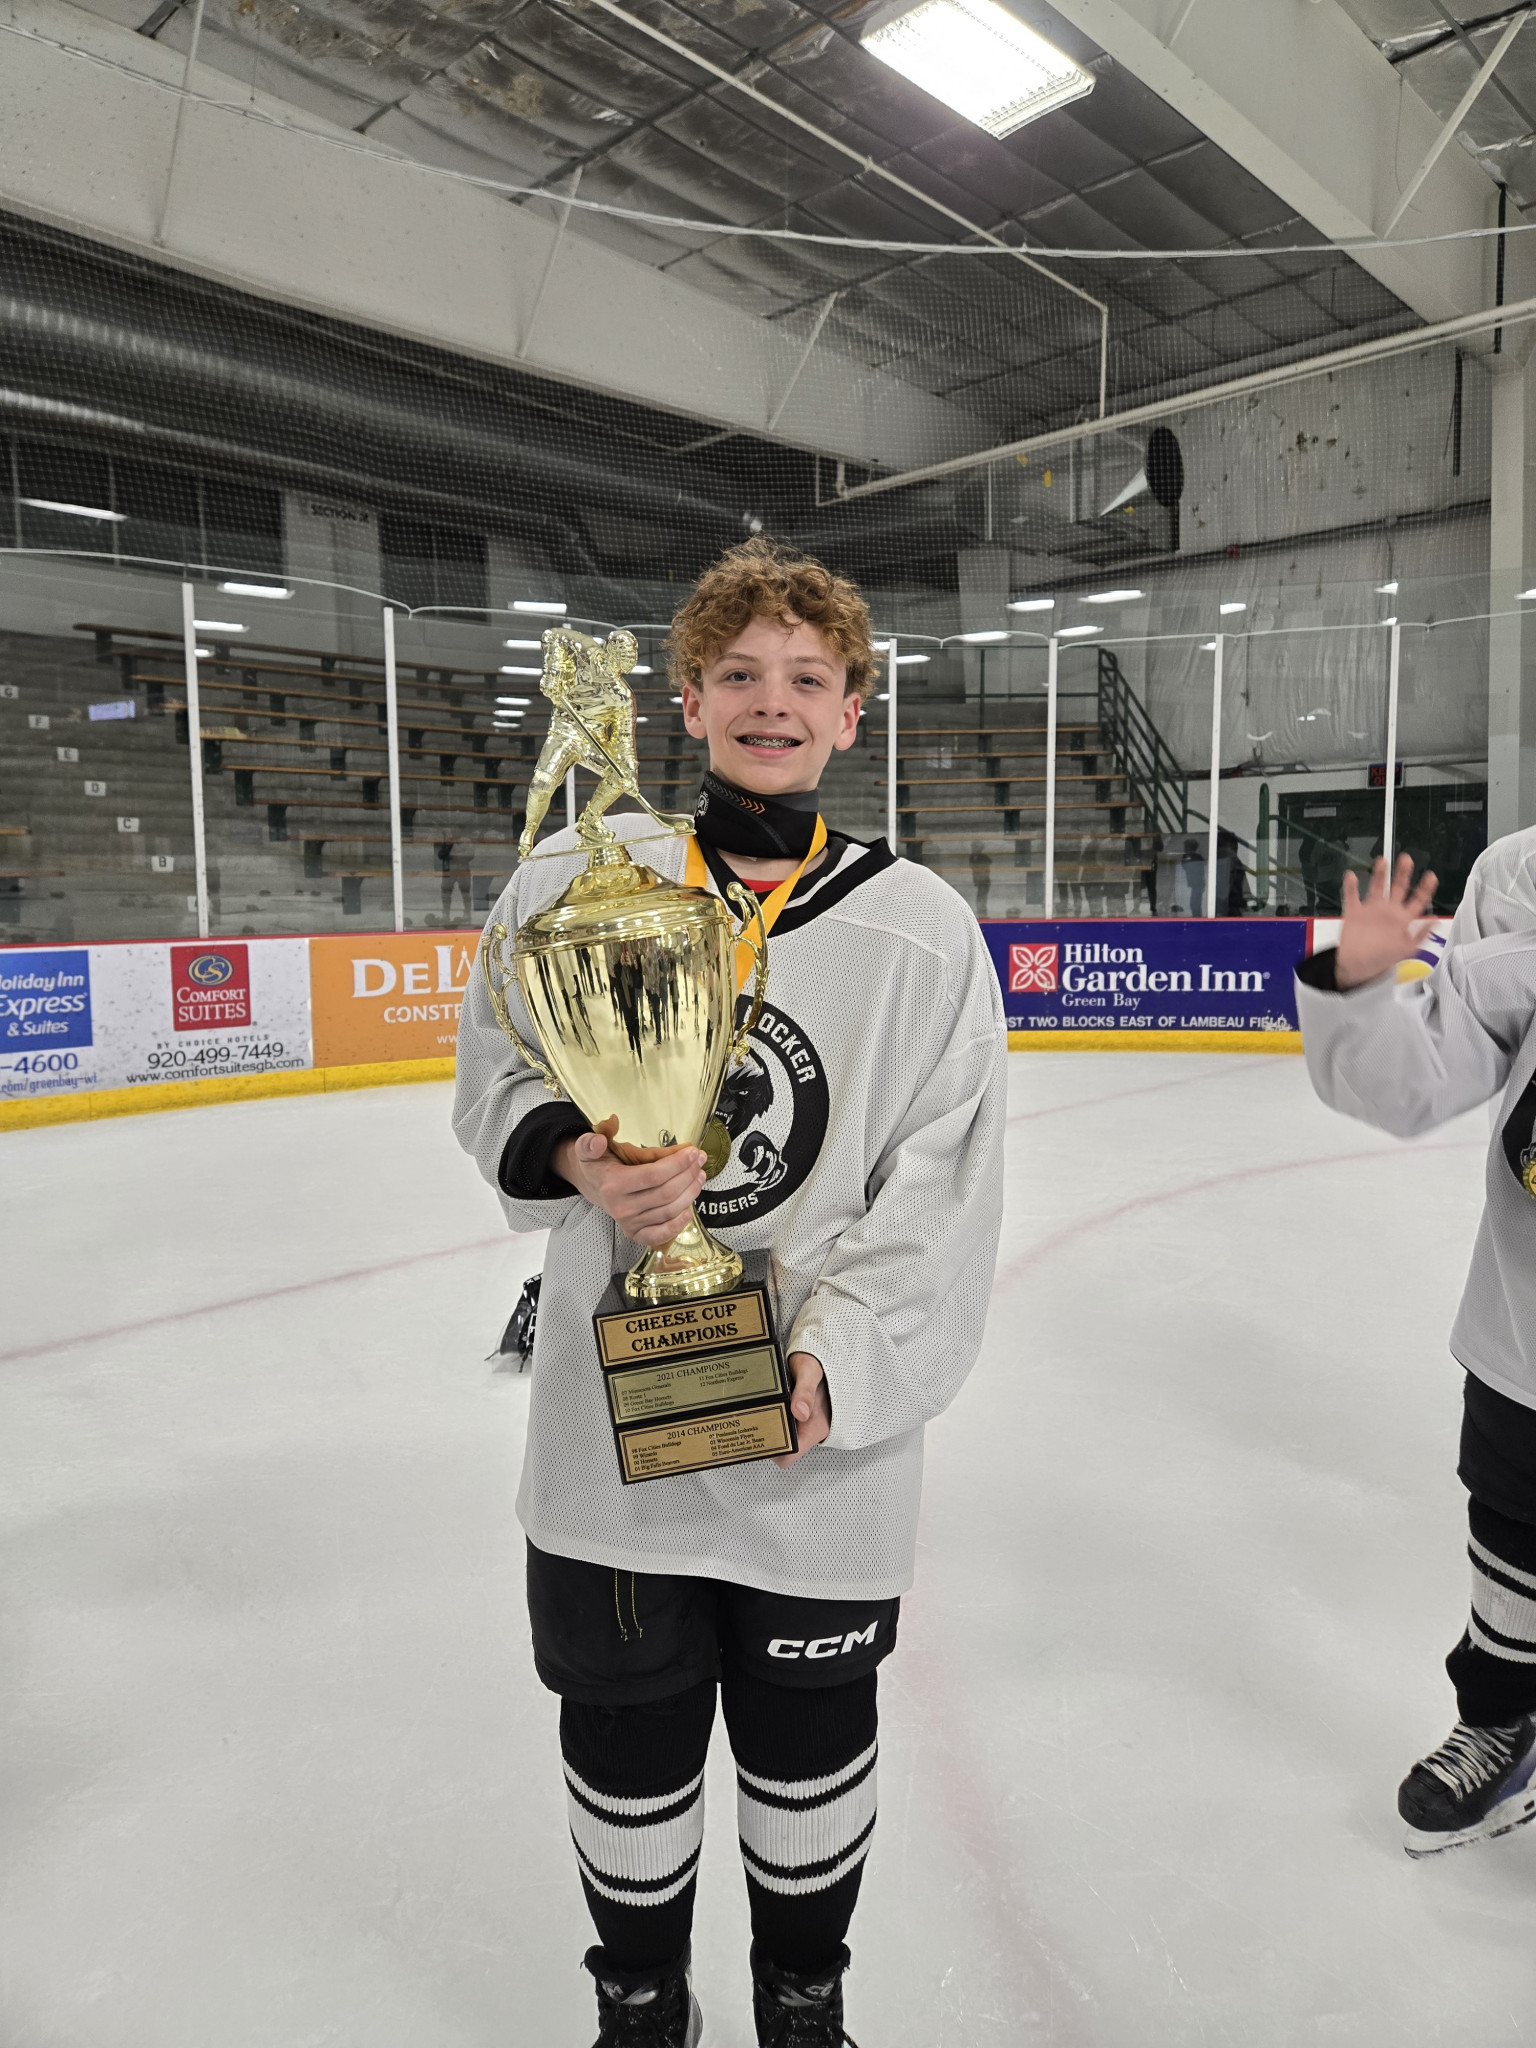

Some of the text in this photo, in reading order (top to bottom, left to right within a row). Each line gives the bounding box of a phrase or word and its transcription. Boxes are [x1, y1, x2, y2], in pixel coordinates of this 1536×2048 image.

[123, 819, 131, 828] C
[159, 857, 167, 867] B
[1064, 944, 1144, 964] Hilton
[58, 971, 84, 987] Inn
[1062, 964, 1265, 992] Garden Inn
[177, 987, 246, 1004] COMFORT
[1062, 993, 1141, 1010] Green Bay
[178, 1002, 246, 1022] SUITES
[7, 1020, 69, 1037] & Suites
[1028, 1016, 1058, 1027] TWO
[1062, 1016, 1115, 1027] BLOCKS
[1120, 1016, 1153, 1027] EAST
[1158, 1016, 1176, 1027] OF
[1181, 1016, 1244, 1027] LAMBEAU
[1250, 1016, 1288, 1029] FIELD
[178, 1038, 220, 1047] CHOICE
[228, 1034, 269, 1044] HOTELS
[148, 1042, 284, 1069] 920-499-7449
[126, 1057, 304, 1083] www.comfortsuitesgb.com
[694, 1192, 758, 1215] ADGERS
[626, 1304, 737, 1334] CHEESE CUP
[632, 1323, 738, 1352] CHAMPIONS
[657, 1362, 730, 1382] 2021 CHAMPIONS
[667, 1420, 740, 1440] 2014 CHAMPIONS
[767, 1620, 878, 1659] CCM
